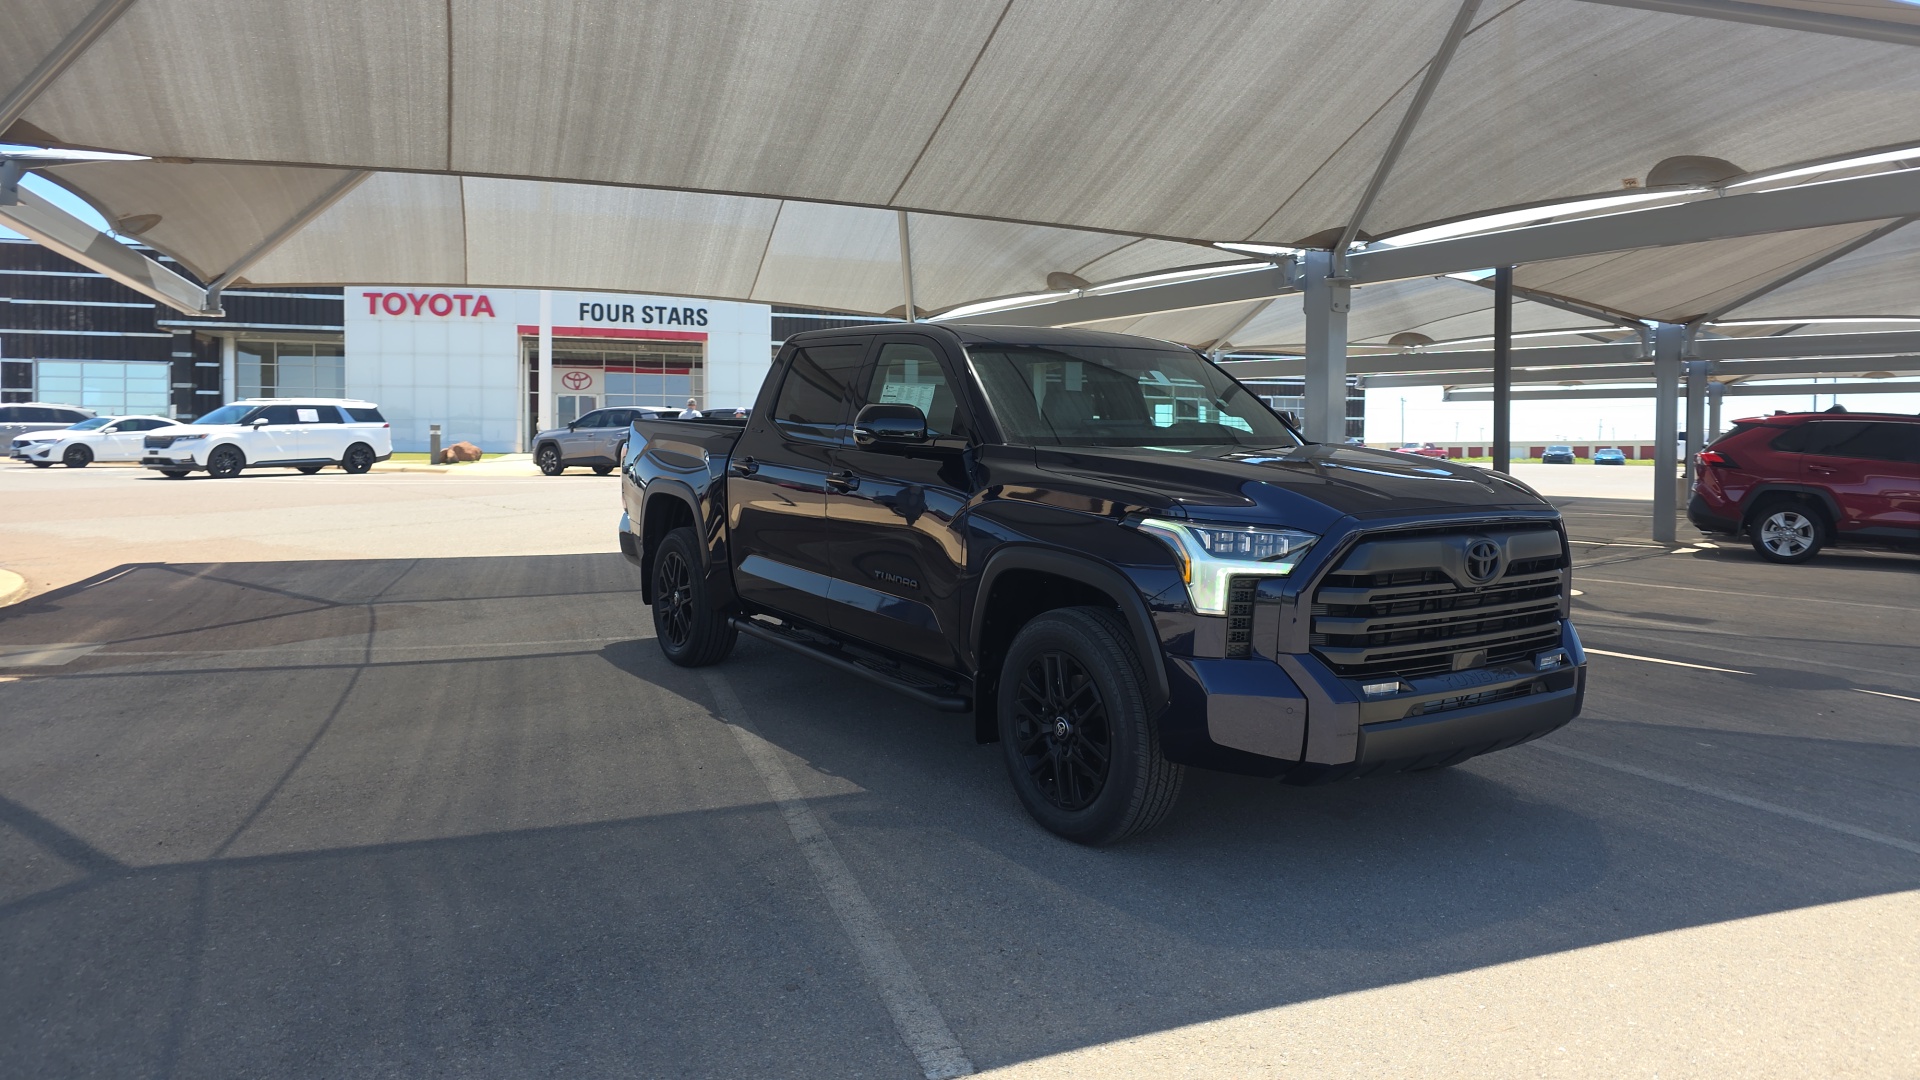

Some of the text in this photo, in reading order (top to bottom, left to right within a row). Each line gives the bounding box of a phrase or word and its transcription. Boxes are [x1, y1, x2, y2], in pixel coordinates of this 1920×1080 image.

[363, 292, 496, 318] TOYOTA
[579, 302, 709, 327] FOUR STARS
[874, 570, 918, 588] TUNDRA
[1441, 667, 1518, 689] TUNDRA
